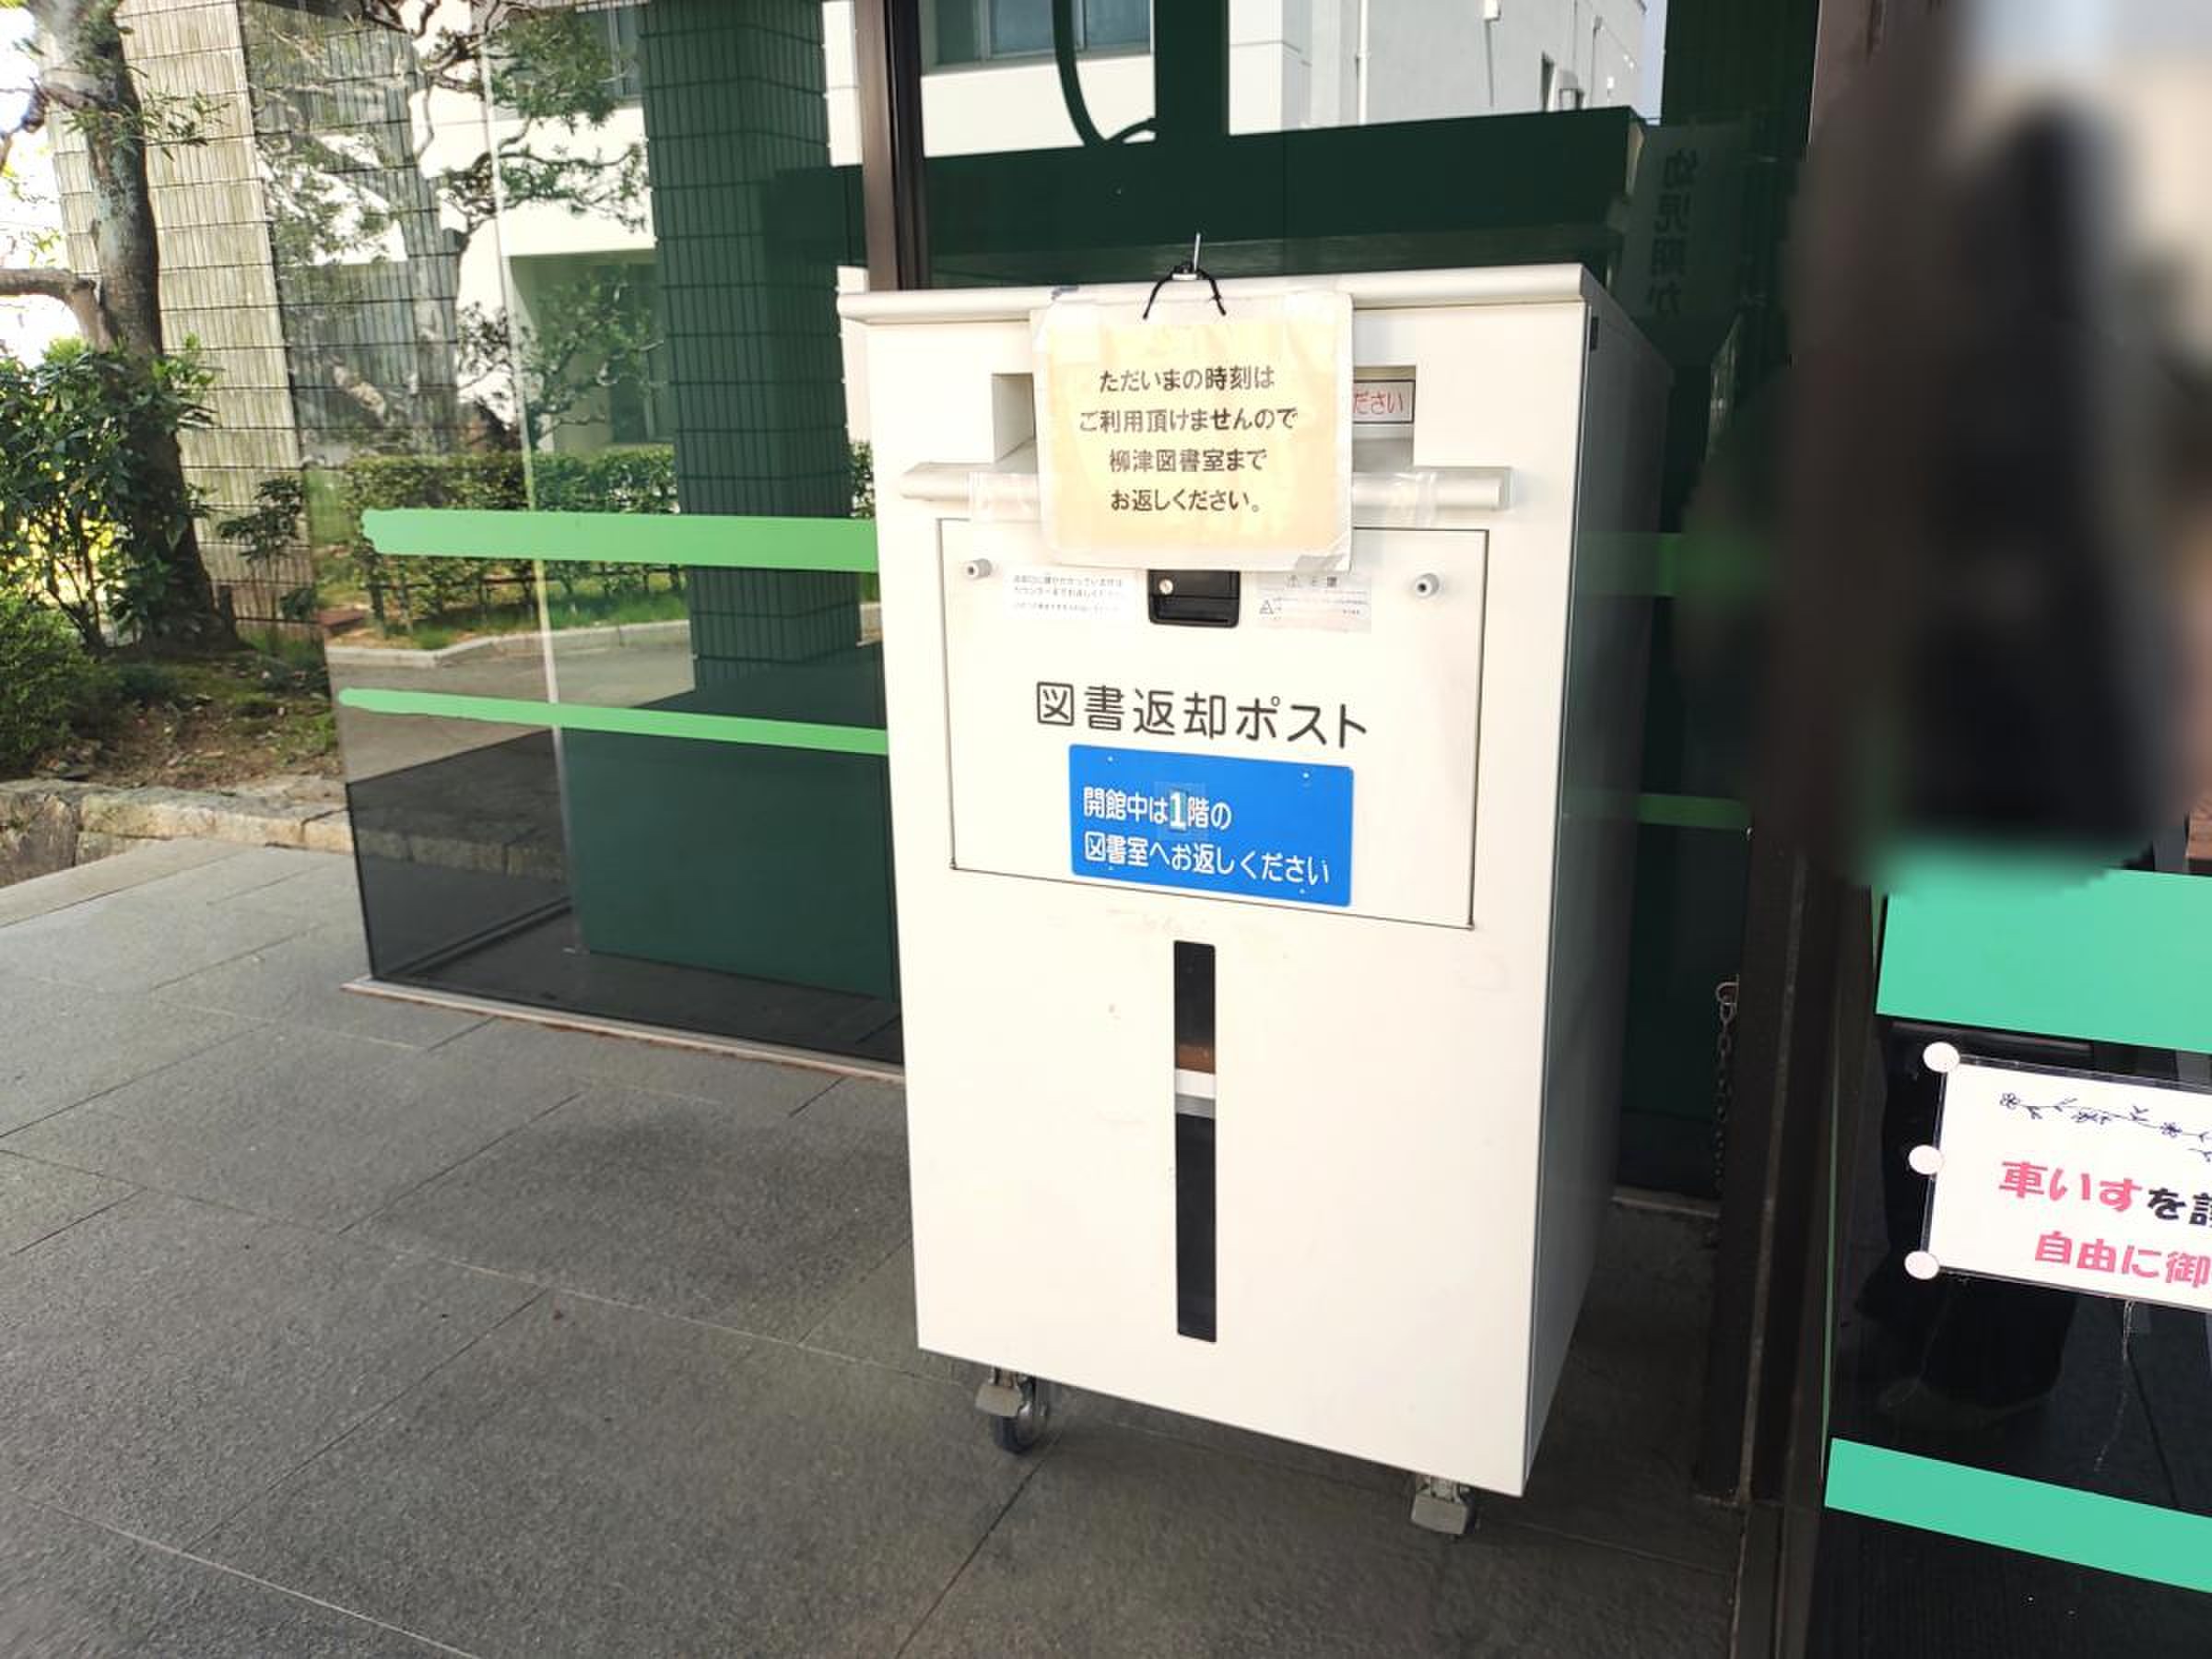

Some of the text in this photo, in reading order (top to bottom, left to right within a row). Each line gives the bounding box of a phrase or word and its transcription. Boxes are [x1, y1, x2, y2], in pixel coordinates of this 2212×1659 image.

[1100, 365, 1275, 393] ただいまの時刻は
[1079, 406, 1299, 433] ご利用頂けませんので
[1109, 448, 1267, 473] 柳津図書室まで
[1110, 488, 1260, 512] お返しください。
[1036, 681, 1368, 748] 図書返却ポスト
[1084, 786, 1233, 832] 開館中は1階の
[1084, 831, 1331, 886] 図書室へお返しください
[2034, 1230, 2211, 1288] 自由に御
